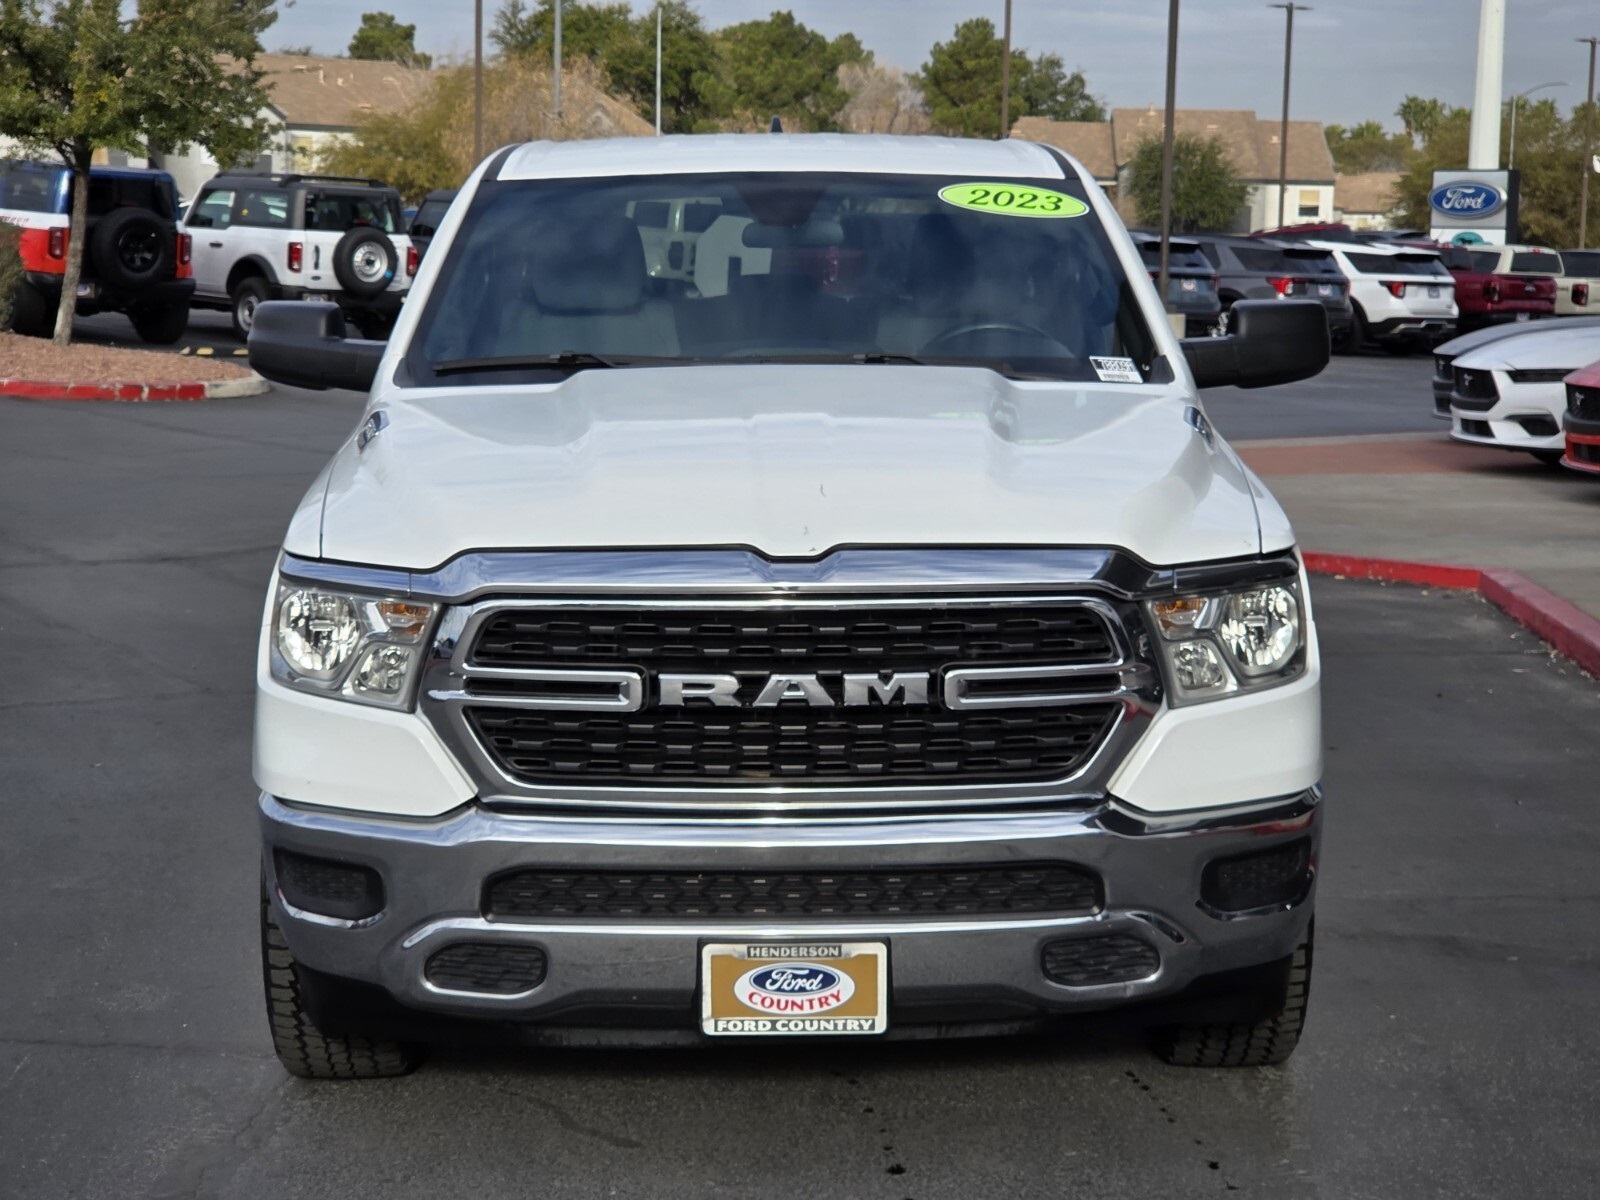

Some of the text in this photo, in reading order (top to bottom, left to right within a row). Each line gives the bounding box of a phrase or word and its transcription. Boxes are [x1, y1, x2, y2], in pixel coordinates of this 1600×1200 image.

[967, 189, 1063, 212] 2023
[1441, 187, 1487, 210] Ford
[658, 673, 930, 707] RAM
[750, 945, 840, 957] HENDERSON
[765, 968, 823, 991] Ford
[748, 989, 842, 1012] COUNTRY
[717, 1018, 873, 1032] FORD COUNTRY
